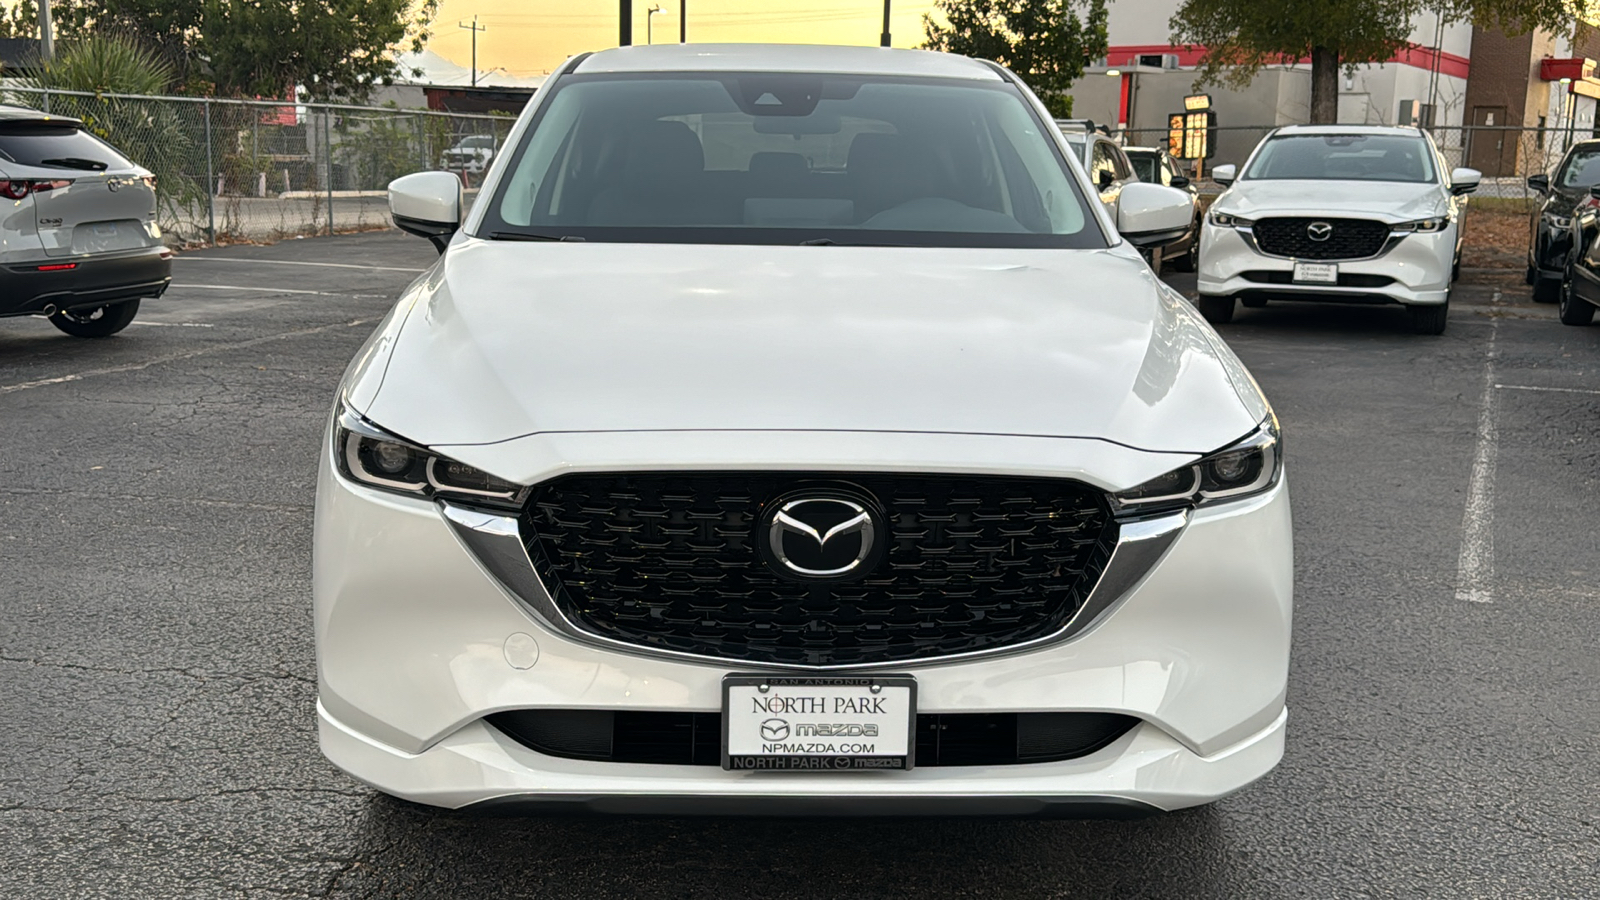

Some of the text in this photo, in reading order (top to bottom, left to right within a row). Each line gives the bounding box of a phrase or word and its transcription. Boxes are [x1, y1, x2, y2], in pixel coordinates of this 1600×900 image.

[752, 697, 887, 714] NORTH PARK
[796, 724, 878, 736] mazda
[762, 744, 874, 754] NPMAZDA.COM
[734, 756, 902, 768] NORTH PARK mazda
